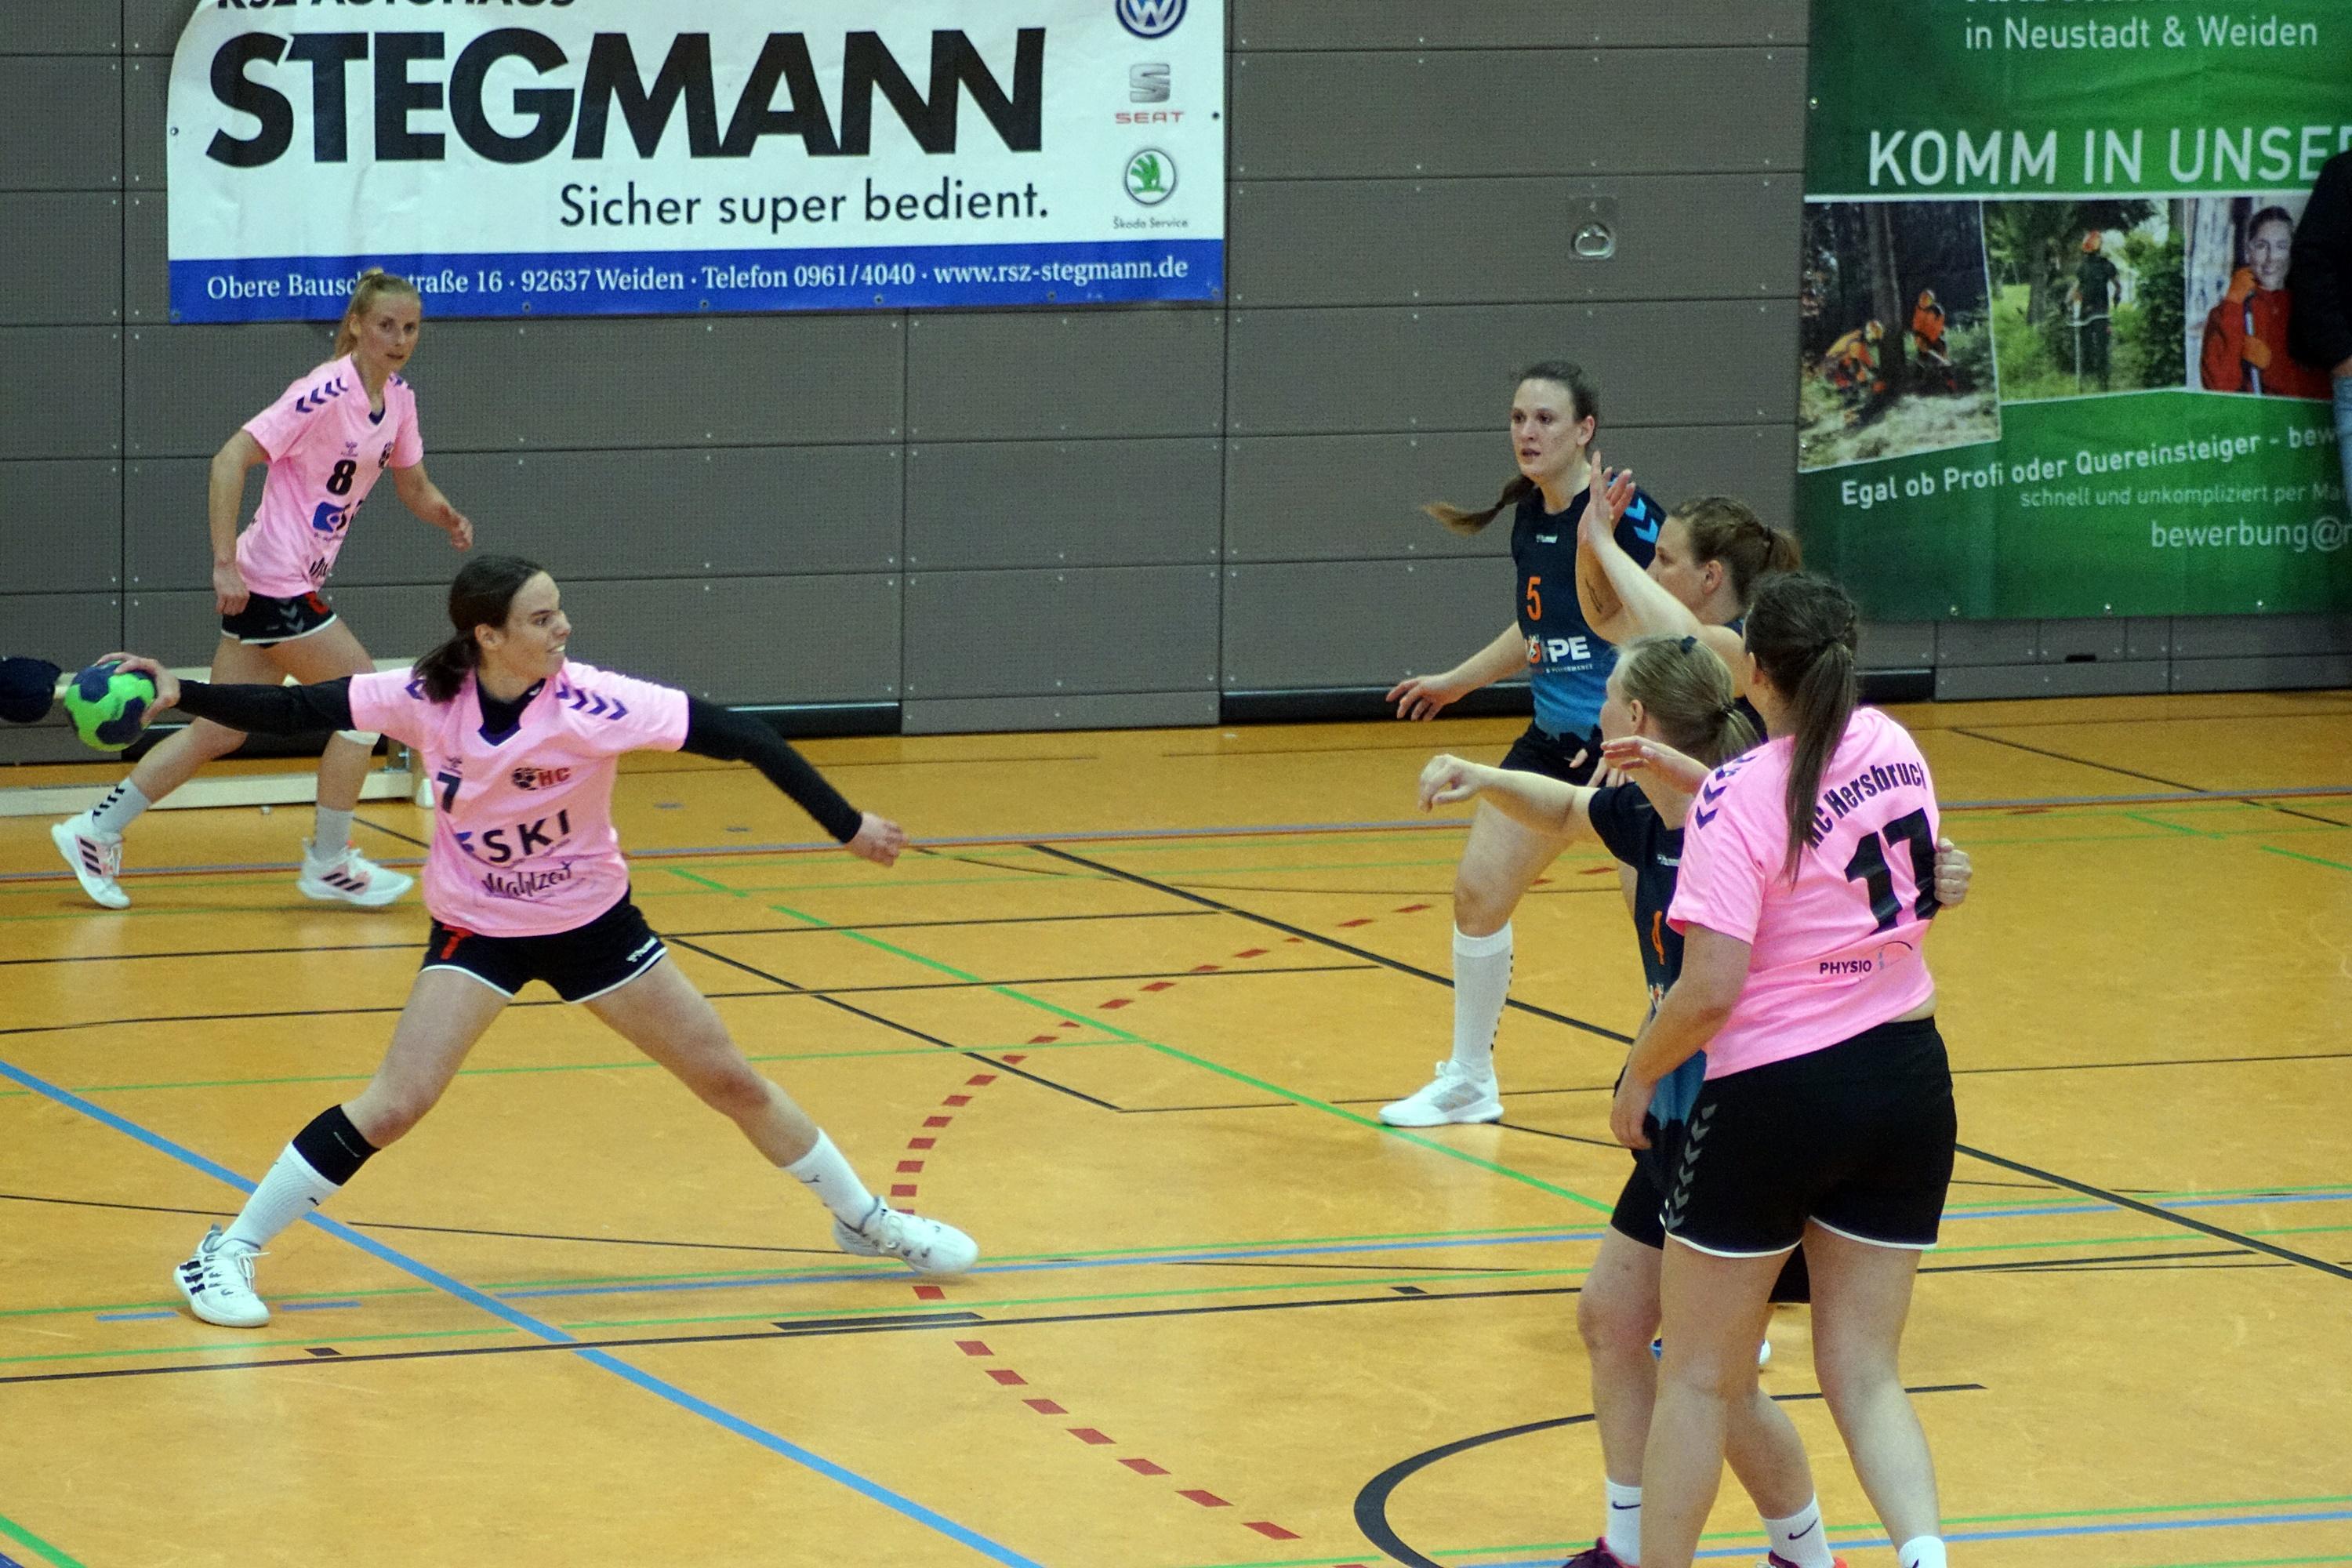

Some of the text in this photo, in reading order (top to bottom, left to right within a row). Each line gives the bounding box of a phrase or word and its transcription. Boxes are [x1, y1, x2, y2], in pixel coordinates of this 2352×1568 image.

[1965, 14, 2318, 49] in Neustadt & Weiden
[205, 27, 1046, 168] STEGMANN
[1116, 111, 1185, 124] SEAT
[1869, 129, 2057, 186] KOMM
[2083, 128, 2143, 184] IN
[560, 176, 1048, 234] Sicher super bedient.
[207, 274, 281, 299] Obere
[477, 270, 503, 292] 16
[521, 268, 591, 292] 92637
[596, 267, 684, 291] Weiden
[702, 265, 787, 289] Telefon
[793, 263, 916, 287] 0961/4040
[933, 255, 1189, 287] www.rsz-stegmann.de
[326, 459, 358, 496] 8
[1842, 474, 1898, 510] Egal
[1905, 471, 1936, 497] ob
[1944, 462, 2004, 492] Profi
[2011, 456, 2069, 484] oder
[2076, 434, 2261, 475] Quereinsteiger
[2020, 487, 2090, 507] schnell
[2095, 486, 2132, 506] und
[2136, 483, 2268, 508] unkompliziert
[2274, 485, 2307, 506] per
[1526, 575, 1543, 621] 5
[437, 771, 462, 814] 7
[539, 768, 571, 787] HC
[482, 808, 570, 864] SKI
[1844, 808, 1944, 935] 17
[1819, 959, 1873, 975] PHYSIO
